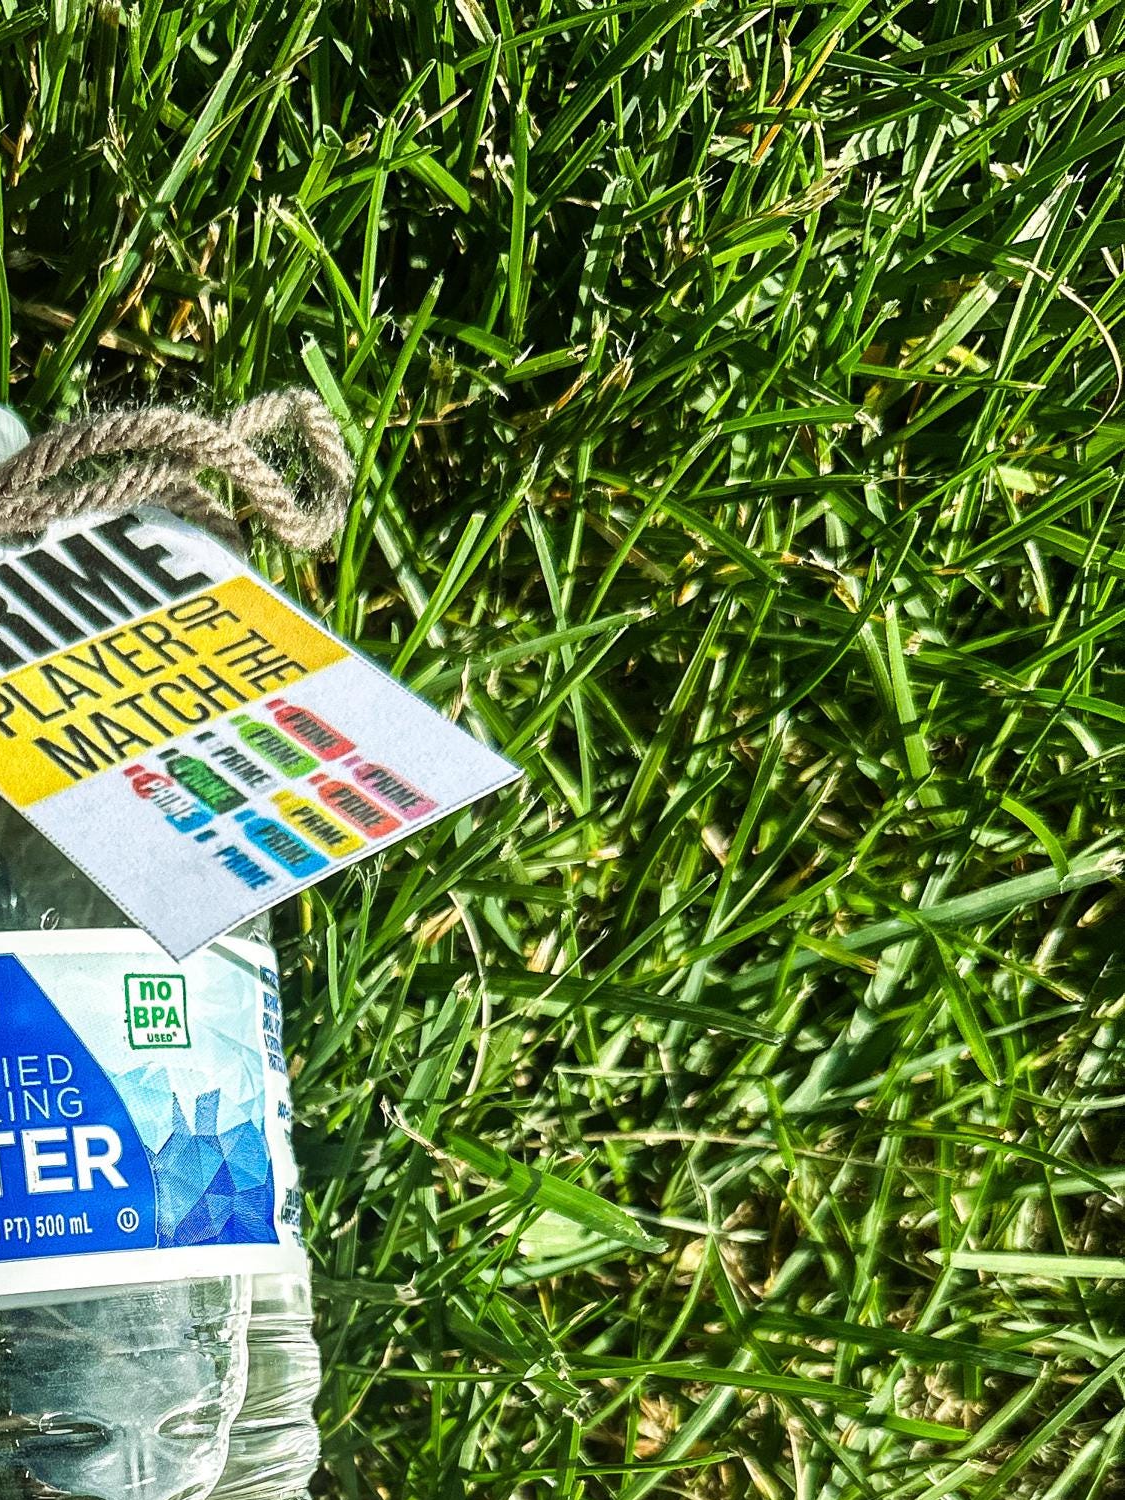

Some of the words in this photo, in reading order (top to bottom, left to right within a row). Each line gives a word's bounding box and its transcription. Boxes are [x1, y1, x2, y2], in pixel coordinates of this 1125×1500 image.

[167, 595, 242, 633] OF
[213, 629, 308, 691] THE
[34, 664, 250, 781] MATCH
[209, 745, 272, 789] PRIME
[139, 981, 172, 1001] no
[133, 1006, 182, 1029] BPA
[4, 1217, 31, 1243] PT)
[35, 1214, 65, 1238] 500
[69, 1213, 93, 1235] mL
